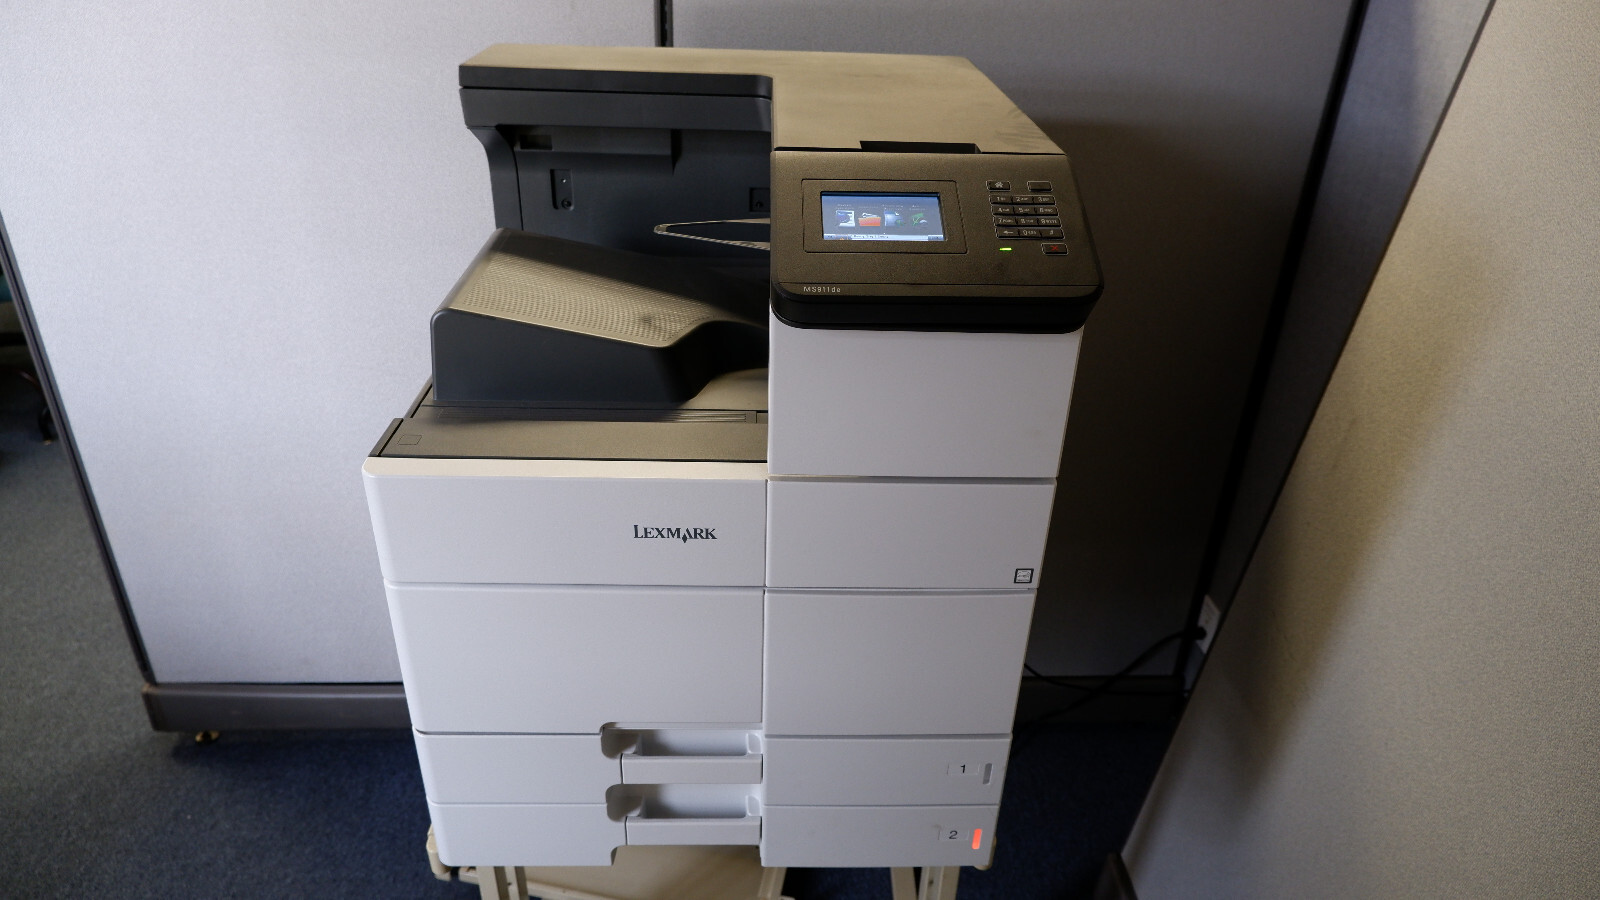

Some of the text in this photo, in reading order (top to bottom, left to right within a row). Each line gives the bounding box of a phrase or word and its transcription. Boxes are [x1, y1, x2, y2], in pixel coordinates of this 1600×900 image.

[633, 524, 718, 544] LEXMARK
[960, 764, 965, 773] 1
[949, 830, 958, 839] 2
